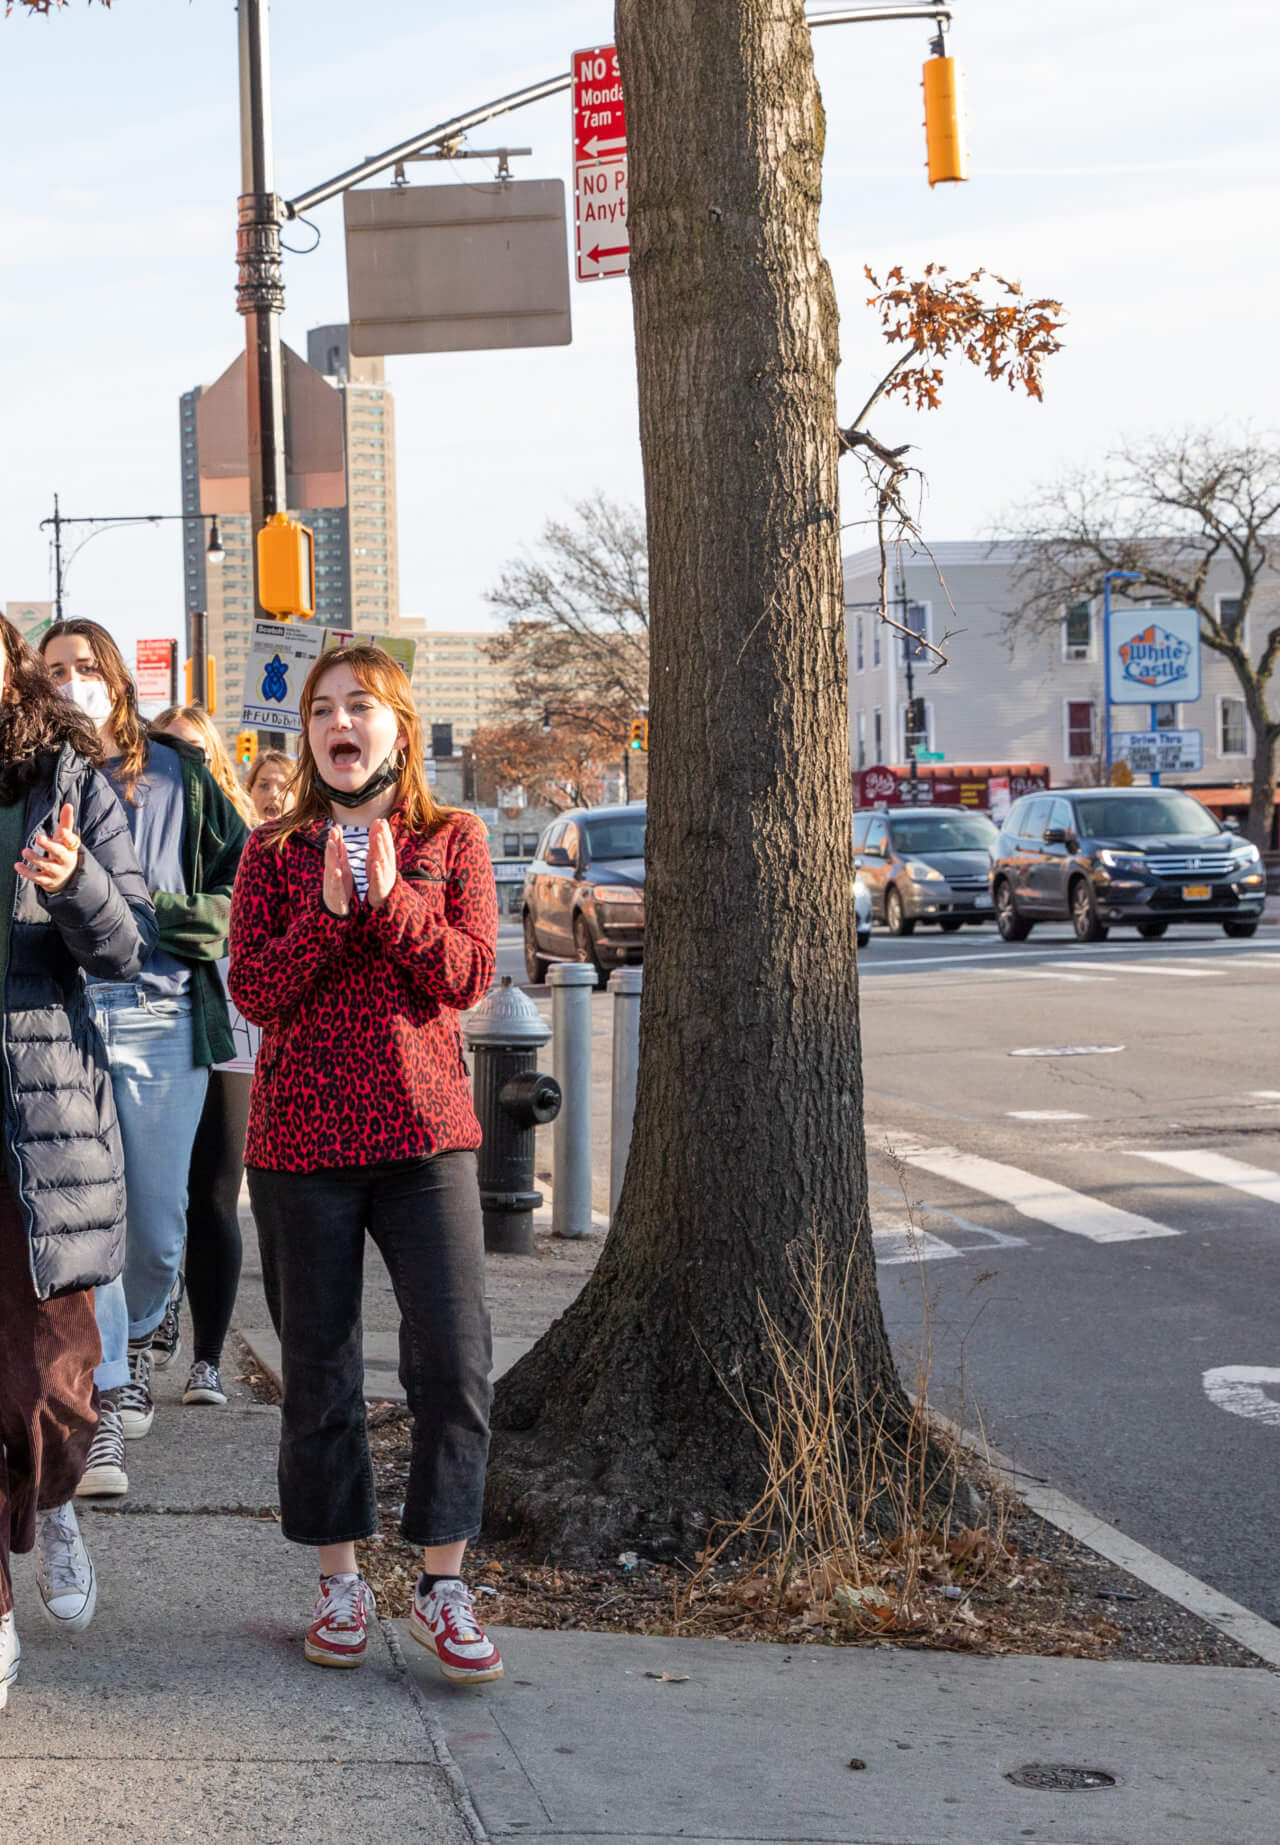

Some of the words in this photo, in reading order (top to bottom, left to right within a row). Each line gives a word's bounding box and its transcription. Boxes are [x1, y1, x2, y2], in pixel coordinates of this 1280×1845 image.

[581, 57, 606, 83] NO
[581, 83, 624, 107] Monda
[581, 110, 612, 128] 7am
[583, 173, 608, 196] NO
[585, 196, 626, 223] Anyt
[1129, 645, 1183, 662] White
[1125, 660, 1186, 679] Castle
[1130, 735, 1157, 745] Drive
[1160, 733, 1183, 743] Thru
